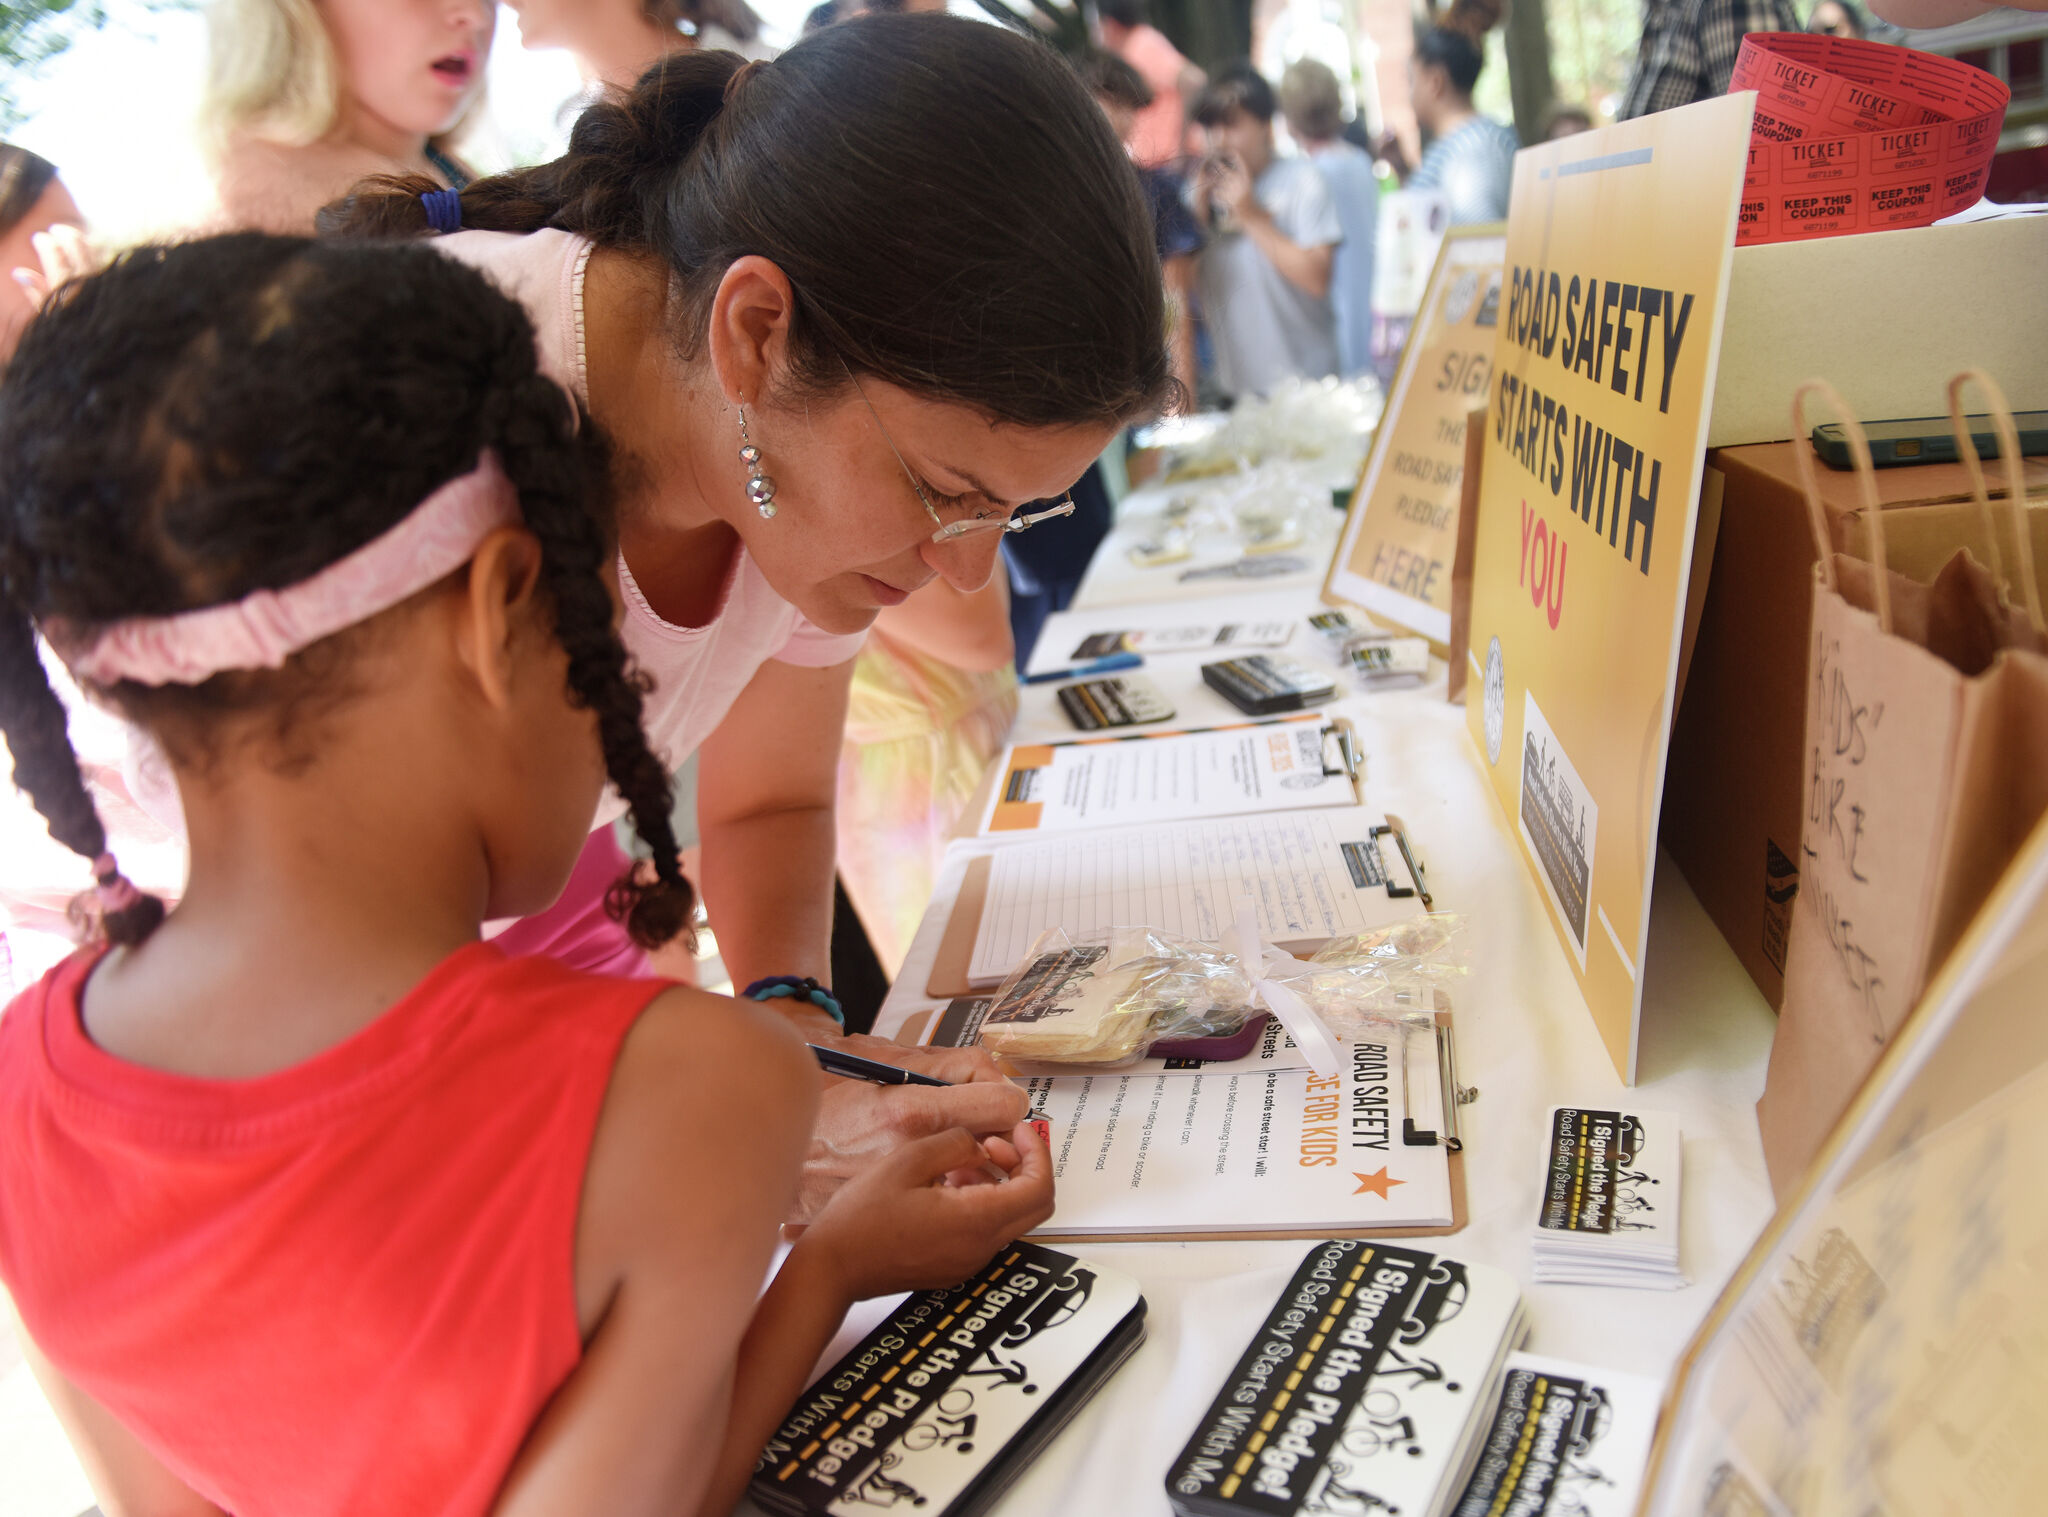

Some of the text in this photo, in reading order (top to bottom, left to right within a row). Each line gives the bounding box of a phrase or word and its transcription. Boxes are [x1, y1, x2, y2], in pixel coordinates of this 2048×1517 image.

[1774, 62, 1819, 89] TICKET
[1849, 88, 1897, 116] TICKET
[1778, 121, 1803, 138] THIS
[1957, 117, 1990, 139] TICKET
[1792, 142, 1845, 160] TICKET
[1881, 131, 1929, 151] TICKET
[1945, 175, 1967, 188] KEEP
[1948, 179, 1978, 197] COUPON
[1784, 194, 1853, 210] KEEP THIS
[1872, 184, 1931, 201] KEEP THIS
[1877, 195, 1925, 210] COUPON
[1791, 205, 1845, 219] COUPON
[1507, 265, 1562, 360] ROAD
[1562, 273, 1696, 414] SAFETY
[1394, 452, 1432, 484] ROAD
[1497, 370, 1662, 577] STARTS WITH
[1397, 495, 1453, 532] PLEDGE
[1370, 540, 1443, 603] HERE
[1519, 499, 1568, 631] YOU
[1261, 1023, 1283, 1060] Streets
[1119, 1084, 1128, 1092] on
[1267, 1079, 1278, 1089] be
[1115, 1092, 1127, 1103] the
[1149, 1099, 1160, 1111] am
[1225, 1092, 1237, 1112] before
[1264, 1095, 1278, 1111] safe
[1352, 1043, 1390, 1151] ROAD SAFETY
[1076, 1104, 1086, 1112] to
[1109, 1103, 1123, 1118] right
[1184, 1096, 1200, 1128] whenever
[1303, 1094, 1340, 1124] FOR
[1069, 1112, 1083, 1127] drive
[1106, 1118, 1120, 1133] side
[1142, 1111, 1158, 1130] riding
[1218, 1112, 1234, 1141] crossing
[1261, 1112, 1274, 1135] street
[1065, 1127, 1079, 1140] the
[1104, 1133, 1115, 1141] of
[1138, 1136, 1152, 1151] bike
[1057, 1139, 1073, 1163] speed
[1100, 1141, 1113, 1153] the
[1218, 1141, 1229, 1154] the
[1258, 1135, 1272, 1155] star!
[1299, 1126, 1338, 1167] KIDS
[1588, 1126, 1613, 1174] Signed
[1137, 1152, 1147, 1160] or
[1546, 1109, 1577, 1230] Road Safety Starts With Me
[1588, 1173, 1609, 1193] the
[1579, 1193, 1607, 1230] Pledge!
[833, 1333, 906, 1392] Starts
[1175, 1240, 1357, 1494] Road Safety Starts With Me
[808, 1262, 1051, 1488] I Signed the Pledge!
[1252, 1257, 1417, 1501] I Signed the Pledge!
[1504, 1370, 1535, 1410] Road
[1550, 1385, 1577, 1397] I
[781, 1392, 844, 1440] With
[1488, 1409, 1526, 1457] Safety
[1531, 1396, 1574, 1464] Signed
[1519, 1460, 1554, 1492] the
